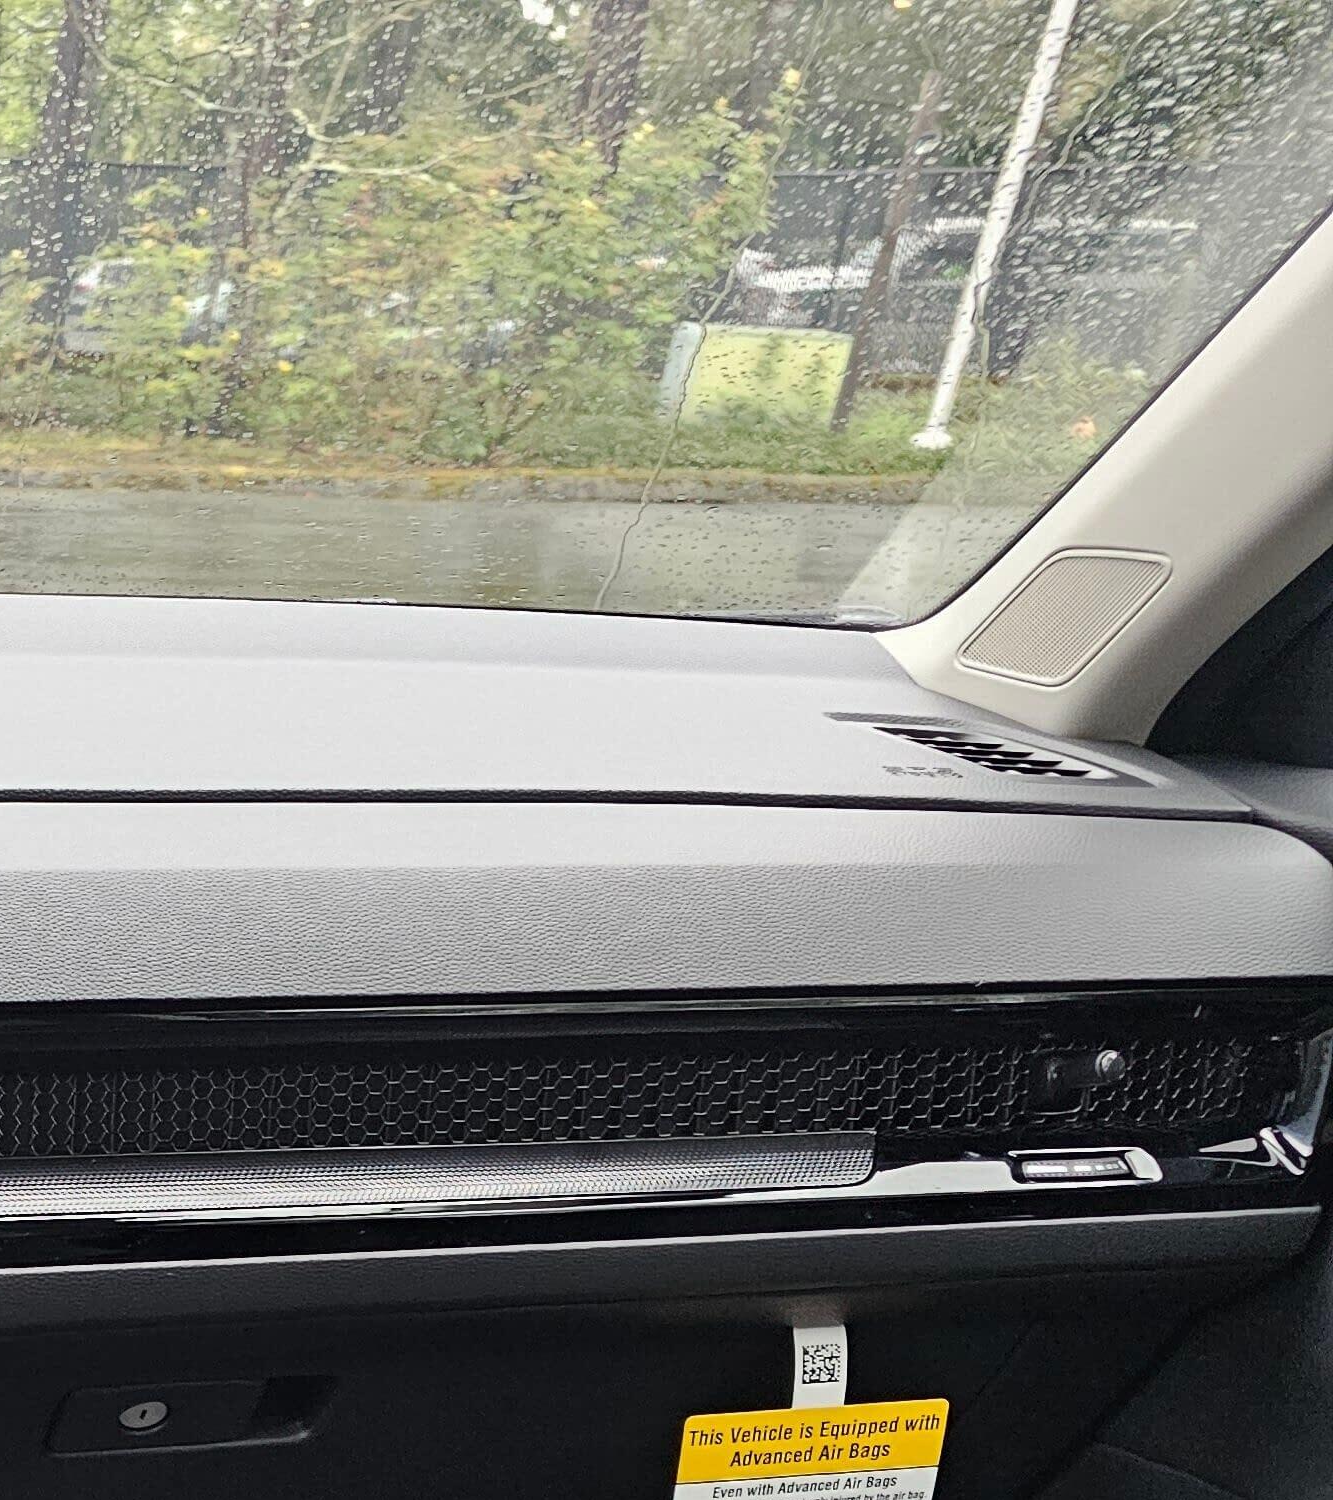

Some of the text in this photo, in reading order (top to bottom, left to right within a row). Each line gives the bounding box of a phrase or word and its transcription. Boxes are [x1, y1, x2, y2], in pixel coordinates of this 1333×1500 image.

[689, 1413, 940, 1446] This Vehicle is Equipped with
[729, 1442, 891, 1467] Advanced Air Bags
[712, 1476, 898, 1498] Even with Advanced Air Bags
[892, 1492, 906, 1500] air
[907, 1491, 927, 1499] bag.
